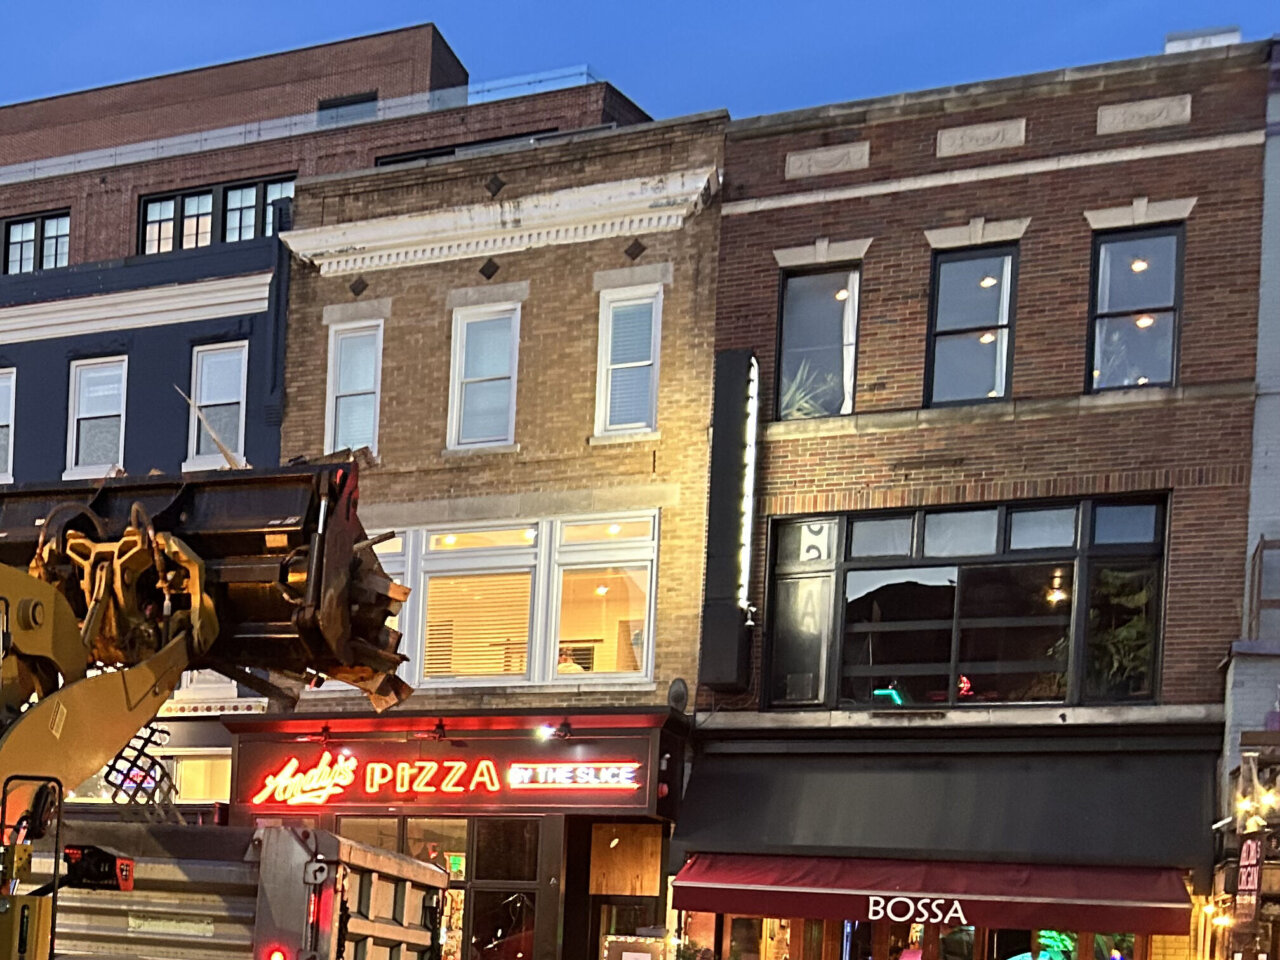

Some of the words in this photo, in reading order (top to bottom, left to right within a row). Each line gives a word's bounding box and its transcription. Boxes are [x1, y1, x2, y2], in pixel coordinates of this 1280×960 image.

[252, 750, 358, 805] Andy's
[365, 759, 501, 793] PIZZA
[537, 766, 573, 784] THE
[575, 767, 636, 785] SLICE
[868, 895, 968, 925] BOSSA
